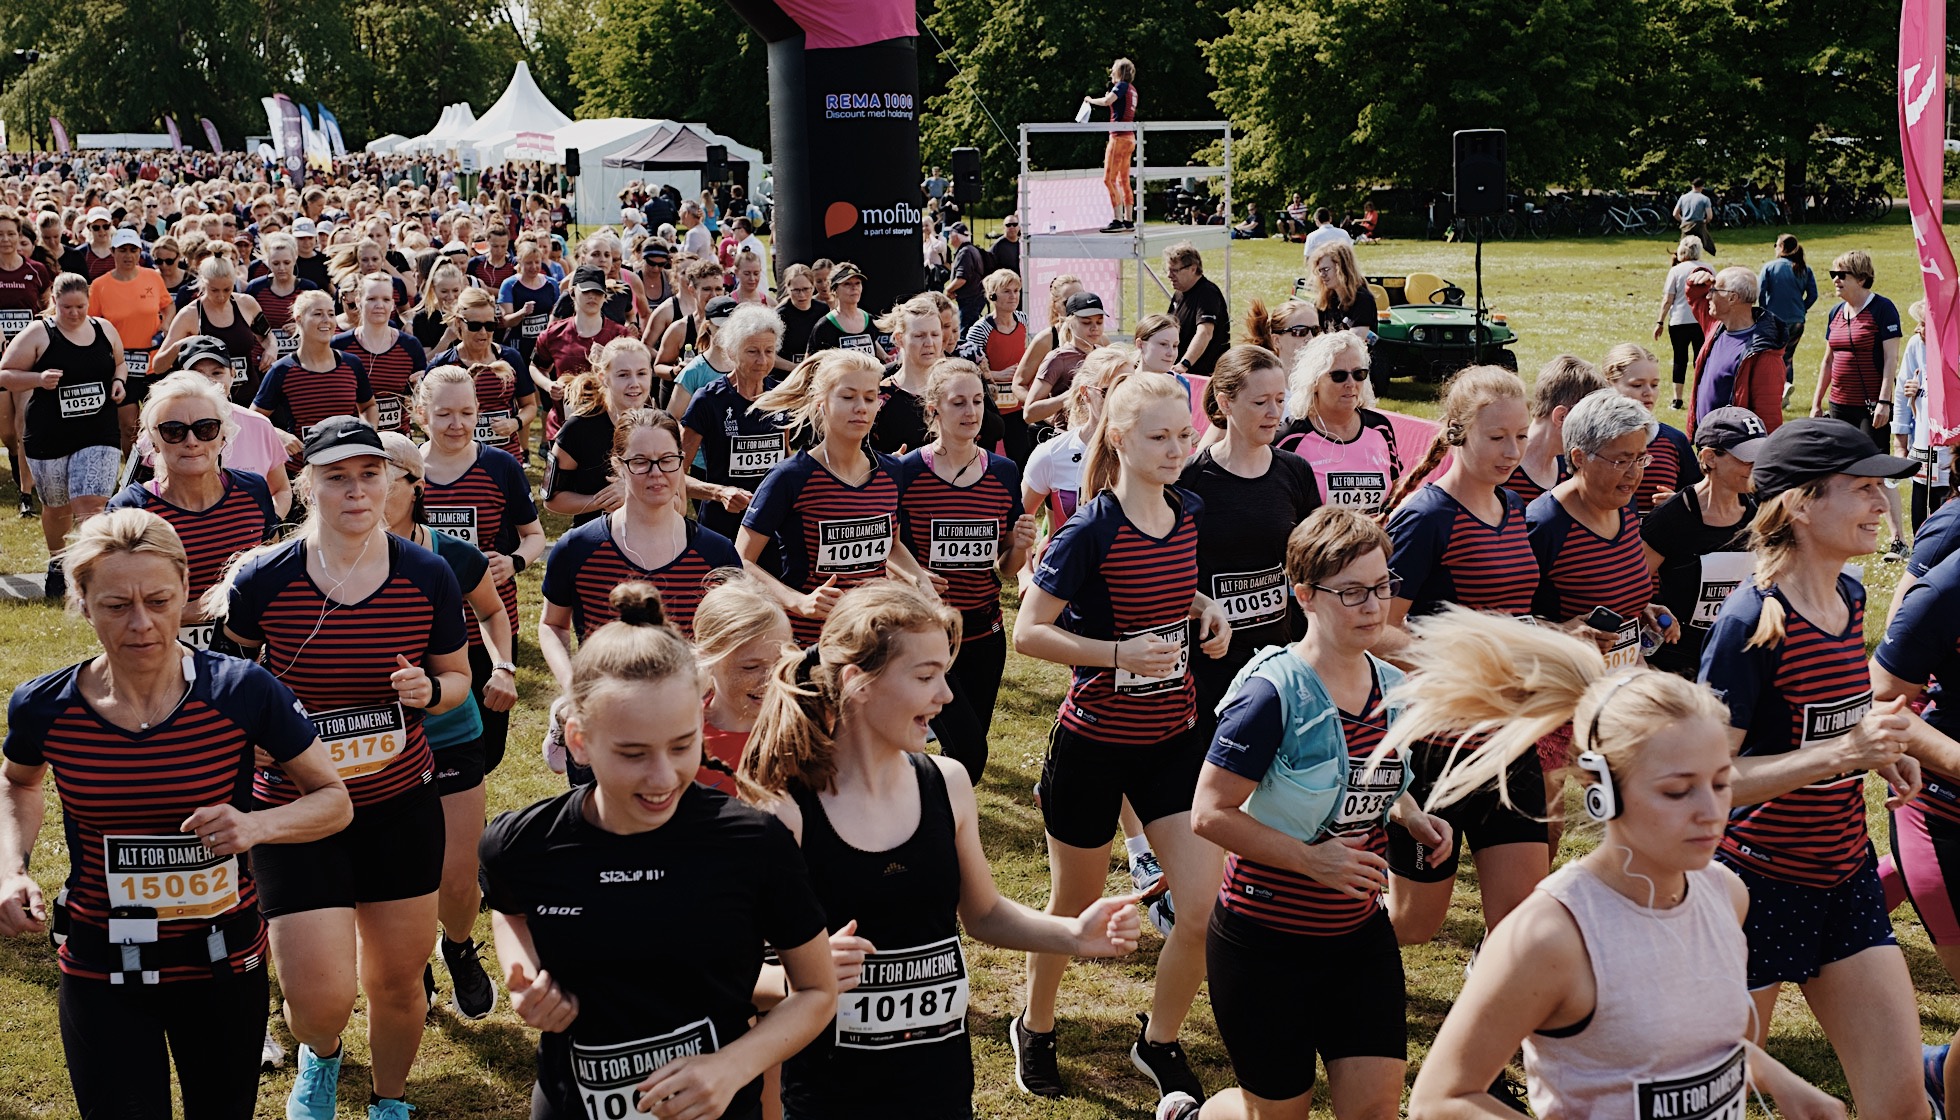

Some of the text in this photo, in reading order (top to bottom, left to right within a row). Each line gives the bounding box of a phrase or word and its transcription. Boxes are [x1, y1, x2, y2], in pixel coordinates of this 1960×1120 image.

[826, 94, 913, 109] REMA 1000
[826, 110, 865, 119] Discount
[868, 110, 885, 118] med
[862, 203, 920, 224] mofibo
[885, 227, 892, 235] of
[1, 321, 29, 329] 10137
[127, 362, 147, 370] 724
[65, 396, 101, 409] 10521
[379, 411, 399, 422] 449
[473, 428, 499, 438] 105
[1742, 417, 1765, 435] H
[736, 438, 781, 450] ALT FOR DAMERNE
[736, 452, 779, 466] 10351
[1332, 476, 1382, 487] ALT FOR DAMERNE
[438, 512, 470, 524] DAMERNE
[827, 521, 886, 540] ALT FOR DAMERNE
[938, 525, 993, 537] ALT FOR DAMERNE
[827, 540, 886, 561] 10014
[937, 542, 992, 557] 10430
[1220, 573, 1281, 593] ALT FOR DAMERNE
[1706, 586, 1717, 598] ALT
[1223, 589, 1283, 615] 10053
[1602, 646, 1635, 670] 5012
[326, 718, 346, 734] FOR
[347, 711, 394, 731] DAMERNE
[1814, 715, 1832, 733] ALT
[1832, 711, 1846, 730] FOR
[330, 734, 395, 762] 5176
[118, 845, 215, 866] ALT FOR DAMER
[121, 866, 229, 901] 15062
[859, 951, 958, 984] LT FOR DAMERNE
[854, 985, 957, 1023] 10187
[578, 1058, 597, 1081] ALT
[600, 1057, 631, 1081] FOR
[1652, 1091, 1679, 1119] ALT
[1682, 1085, 1708, 1114] FOR
